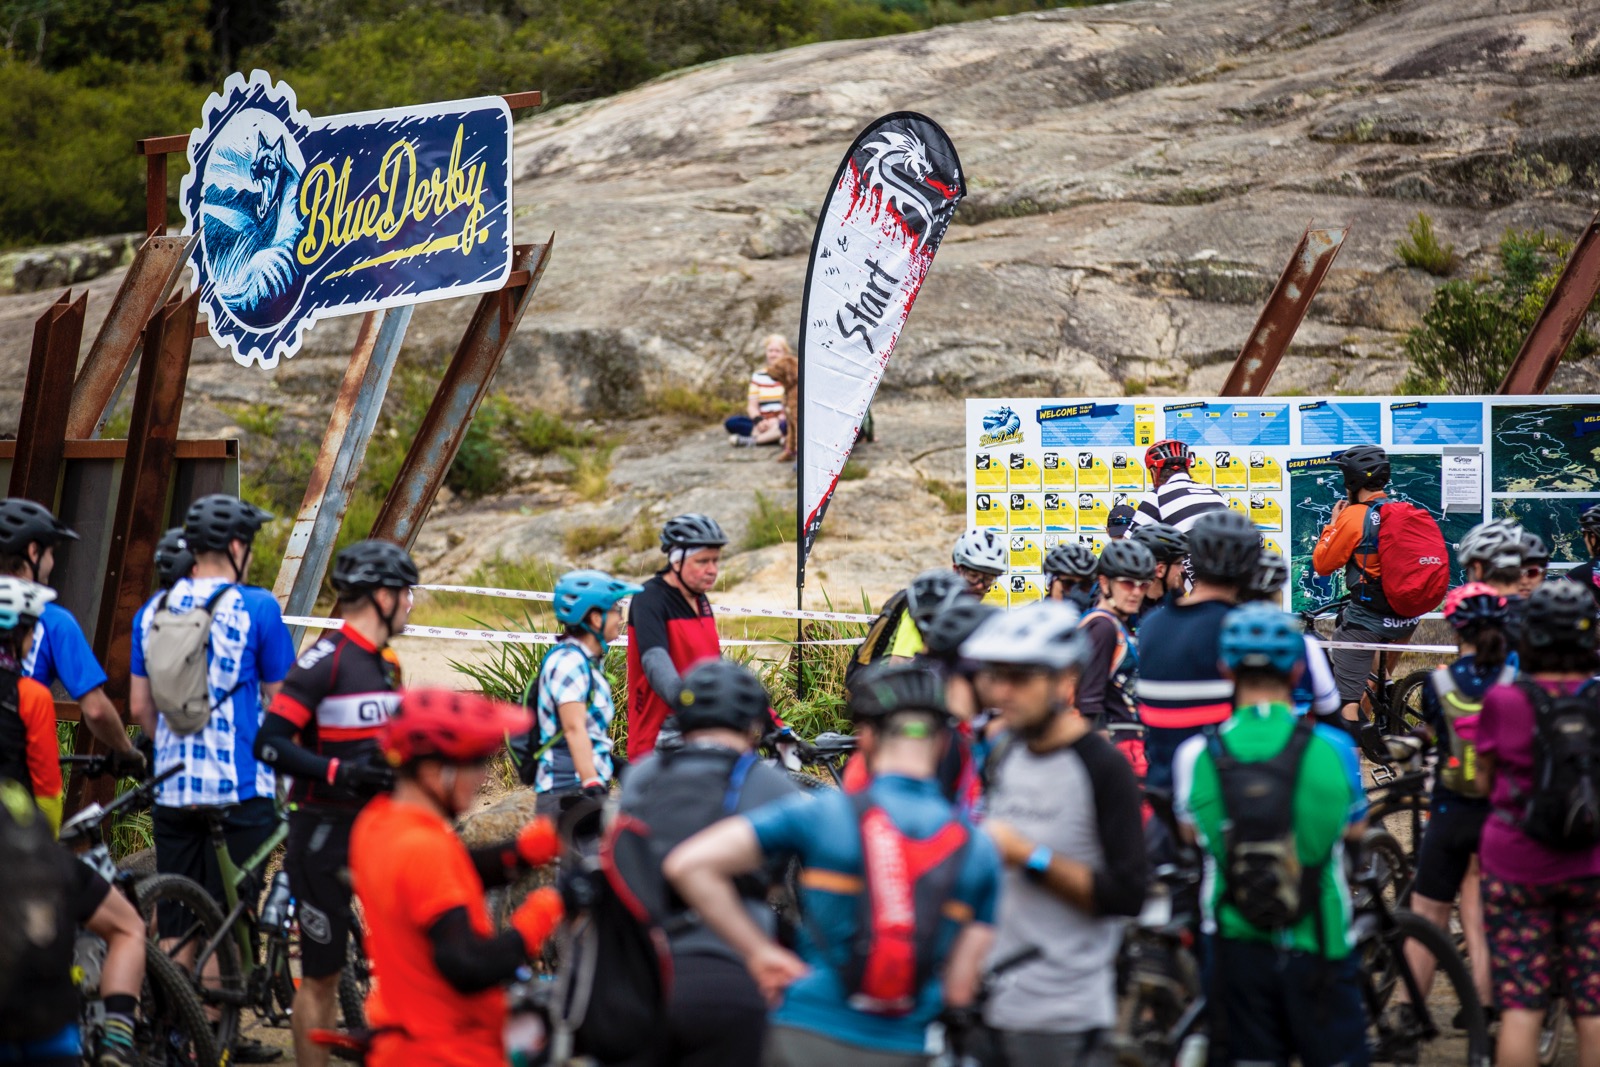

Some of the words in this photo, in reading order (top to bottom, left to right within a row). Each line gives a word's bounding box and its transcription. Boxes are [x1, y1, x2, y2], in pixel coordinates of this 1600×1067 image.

[836, 258, 899, 354] Start
[1040, 406, 1077, 419] WELCOME
[1289, 460, 1308, 468] DERBY
